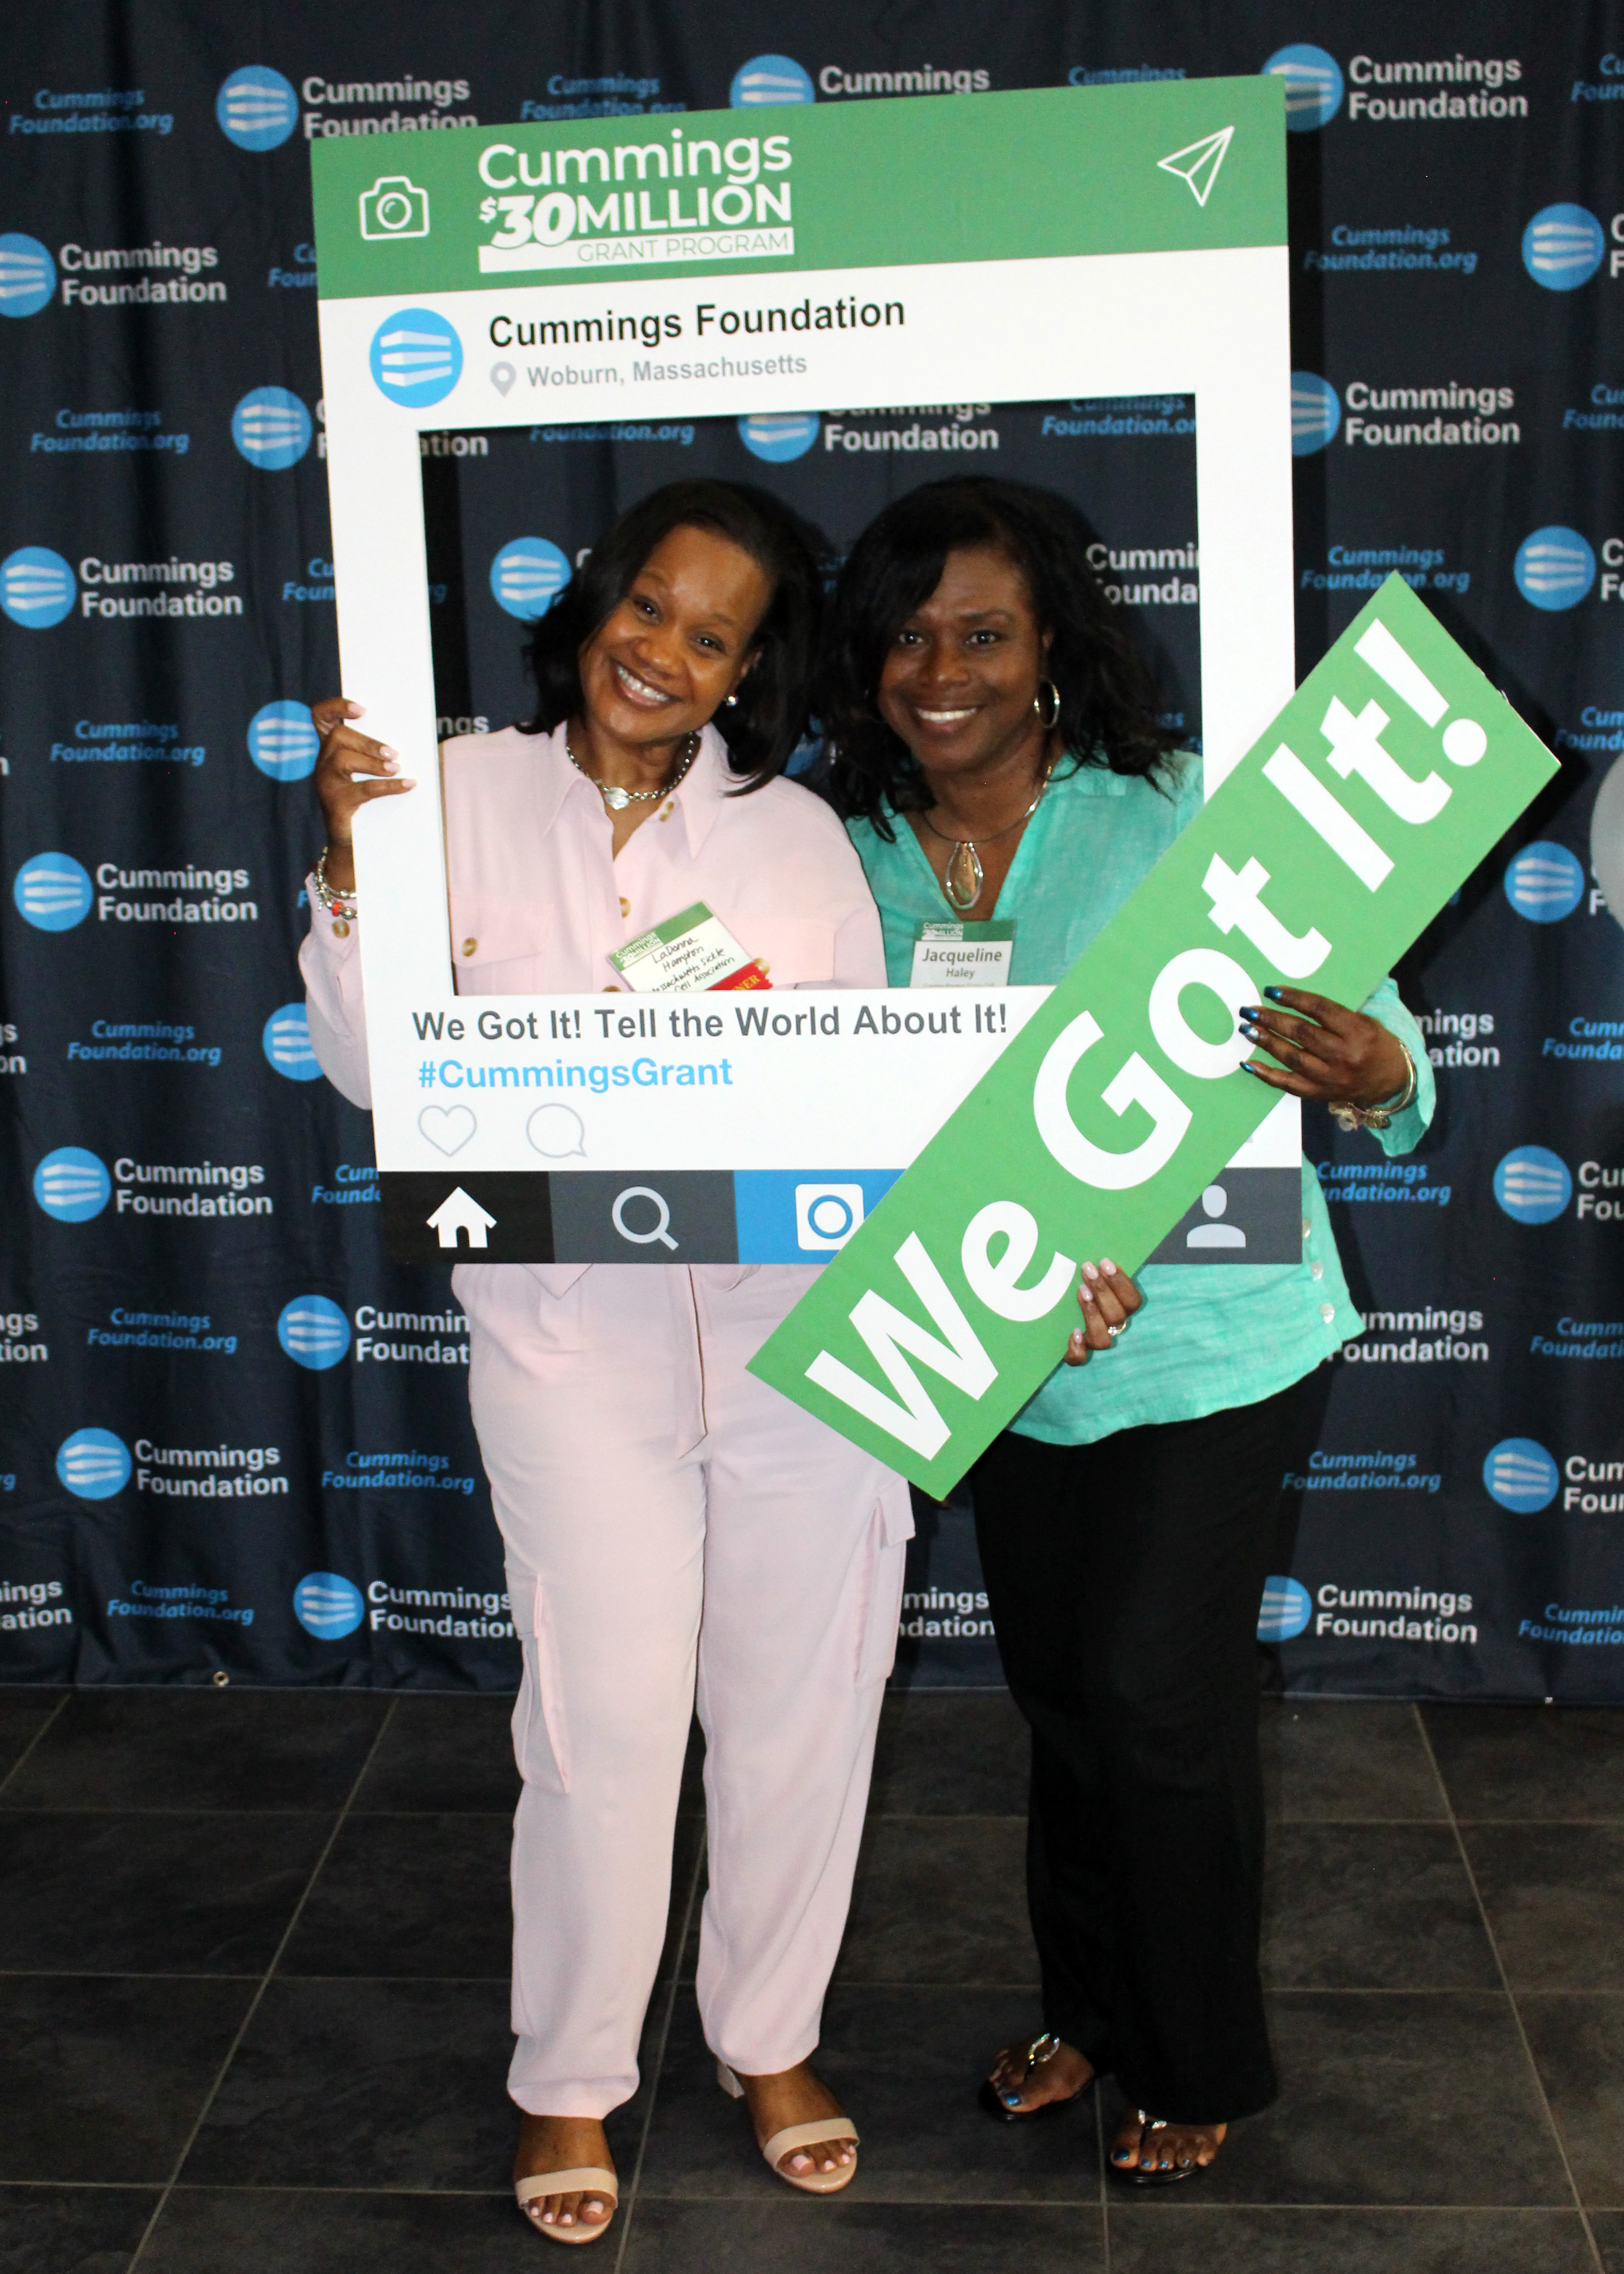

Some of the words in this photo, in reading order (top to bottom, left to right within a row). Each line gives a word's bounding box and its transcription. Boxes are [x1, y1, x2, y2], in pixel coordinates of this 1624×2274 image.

[819, 63, 991, 94] Cummings
[1349, 53, 1522, 87] Cummings
[34, 87, 145, 110] Cummings
[303, 74, 470, 107] Cummings
[547, 71, 660, 99] Cummings
[1349, 89, 1529, 121] Foundation
[10, 111, 174, 135] Foundation.org
[478, 127, 792, 189] Cummings
[577, 239, 659, 262] GRANT
[666, 232, 789, 255] PROGRAM
[1331, 223, 1451, 250] Cummings
[60, 241, 218, 273] Cummings
[1304, 249, 1478, 274] Foundation.org
[61, 276, 227, 305] Foundation
[489, 310, 682, 347] Cummings
[696, 296, 905, 336] Foundation
[528, 365, 625, 387] Woburn,
[633, 354, 807, 381] Massachusetts
[1345, 381, 1515, 416] Cummings
[56, 408, 161, 432] Cummings
[1345, 417, 1521, 446] Foundation
[30, 431, 189, 455] Foundation.org
[825, 423, 999, 452] Foundation
[1086, 542, 1199, 571] Cummi
[1327, 545, 1445, 570] Cummings
[79, 556, 234, 589] Cummings
[81, 589, 243, 618] Foundation
[75, 720, 178, 745] Cummings
[51, 742, 206, 766] Foundation.org
[96, 863, 250, 895] Cummings
[98, 895, 258, 922] Foundation
[651, 937, 699, 964] LaDonna
[662, 945, 704, 973] Hampton
[922, 947, 1002, 966] Jacqueline
[946, 967, 976, 979] Haley
[91, 1020, 194, 1044] Cummings
[412, 1011, 465, 1041] We
[477, 1010, 539, 1040] Got
[551, 1009, 581, 1039] It!
[594, 1008, 657, 1039] Tell
[669, 1008, 723, 1037] the
[734, 1006, 840, 1036] World
[853, 1004, 962, 1035] About
[975, 1003, 1006, 1033] It!
[805, 1200, 1077, 1461] We
[1033, 851, 1333, 1190] Got
[1261, 617, 1488, 893] It!
[68, 1042, 221, 1066] Foundation.org
[1428, 1041, 1501, 1068] ation
[418, 1058, 733, 1093] #CummingsGrant
[114, 1157, 265, 1190] Cummings
[1318, 1161, 1427, 1184] Cummings
[116, 1190, 273, 1217] Foundation
[110, 1308, 210, 1333] Cummings
[355, 1305, 470, 1332] Cummin
[87, 1328, 238, 1355] Foundation.org
[356, 1337, 470, 1365] Foundat
[135, 1438, 281, 1471] Cummings
[346, 1450, 450, 1472] Cummings
[1309, 1450, 1417, 1473] Cummings
[136, 1468, 289, 1498] Foundation
[321, 1471, 475, 1495] Foundation.org
[1282, 1471, 1441, 1493] Foundation.org
[131, 1580, 229, 1605] Cummings
[903, 1586, 990, 1615] mings
[1318, 1584, 1473, 1617] Cummings
[107, 1598, 254, 1626] Foundation.org
[1316, 1613, 1478, 1644] Foundation
